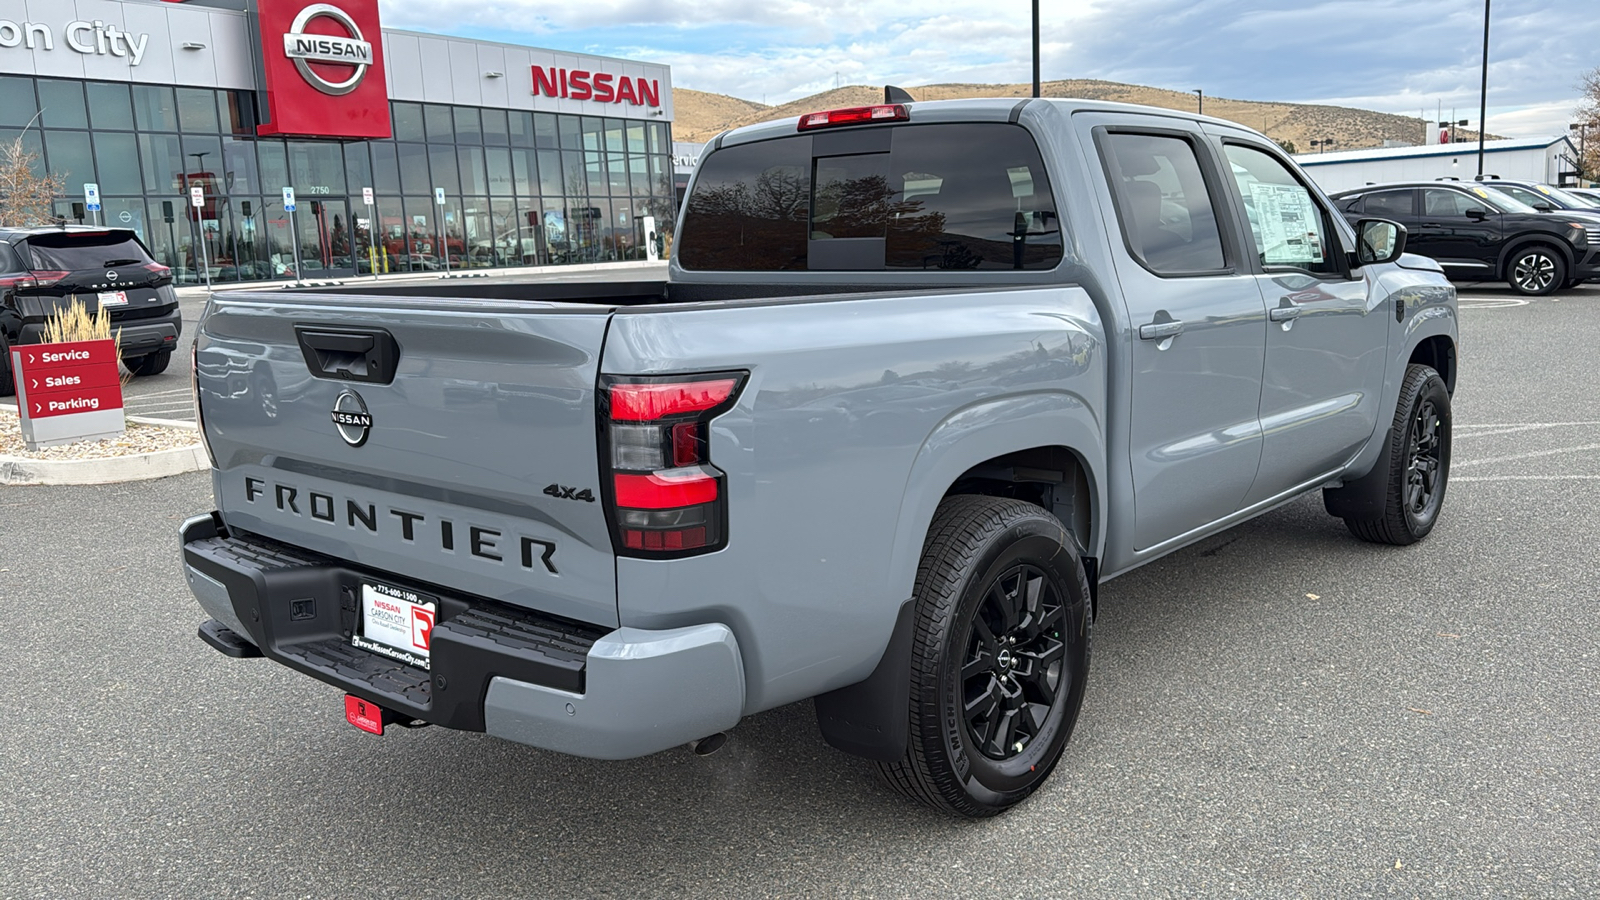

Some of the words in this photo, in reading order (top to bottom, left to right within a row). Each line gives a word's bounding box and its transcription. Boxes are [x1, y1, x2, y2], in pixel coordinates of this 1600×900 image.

[0, 20, 54, 50] on
[66, 20, 149, 66] City
[296, 39, 367, 59] NISSAN
[531, 65, 660, 107] NISSAN
[672, 153, 698, 167] ervic
[310, 186, 330, 195] 2750
[42, 350, 90, 363] Service
[45, 375, 81, 387] Sales
[49, 397, 99, 411] Parking
[331, 412, 370, 426] NISSAN
[245, 477, 559, 574] FRONTIER
[377, 584, 418, 602] 775-600-1500
[374, 600, 401, 613] NISSAN
[371, 608, 394, 621] CARSON
[394, 614, 406, 625] CITY
